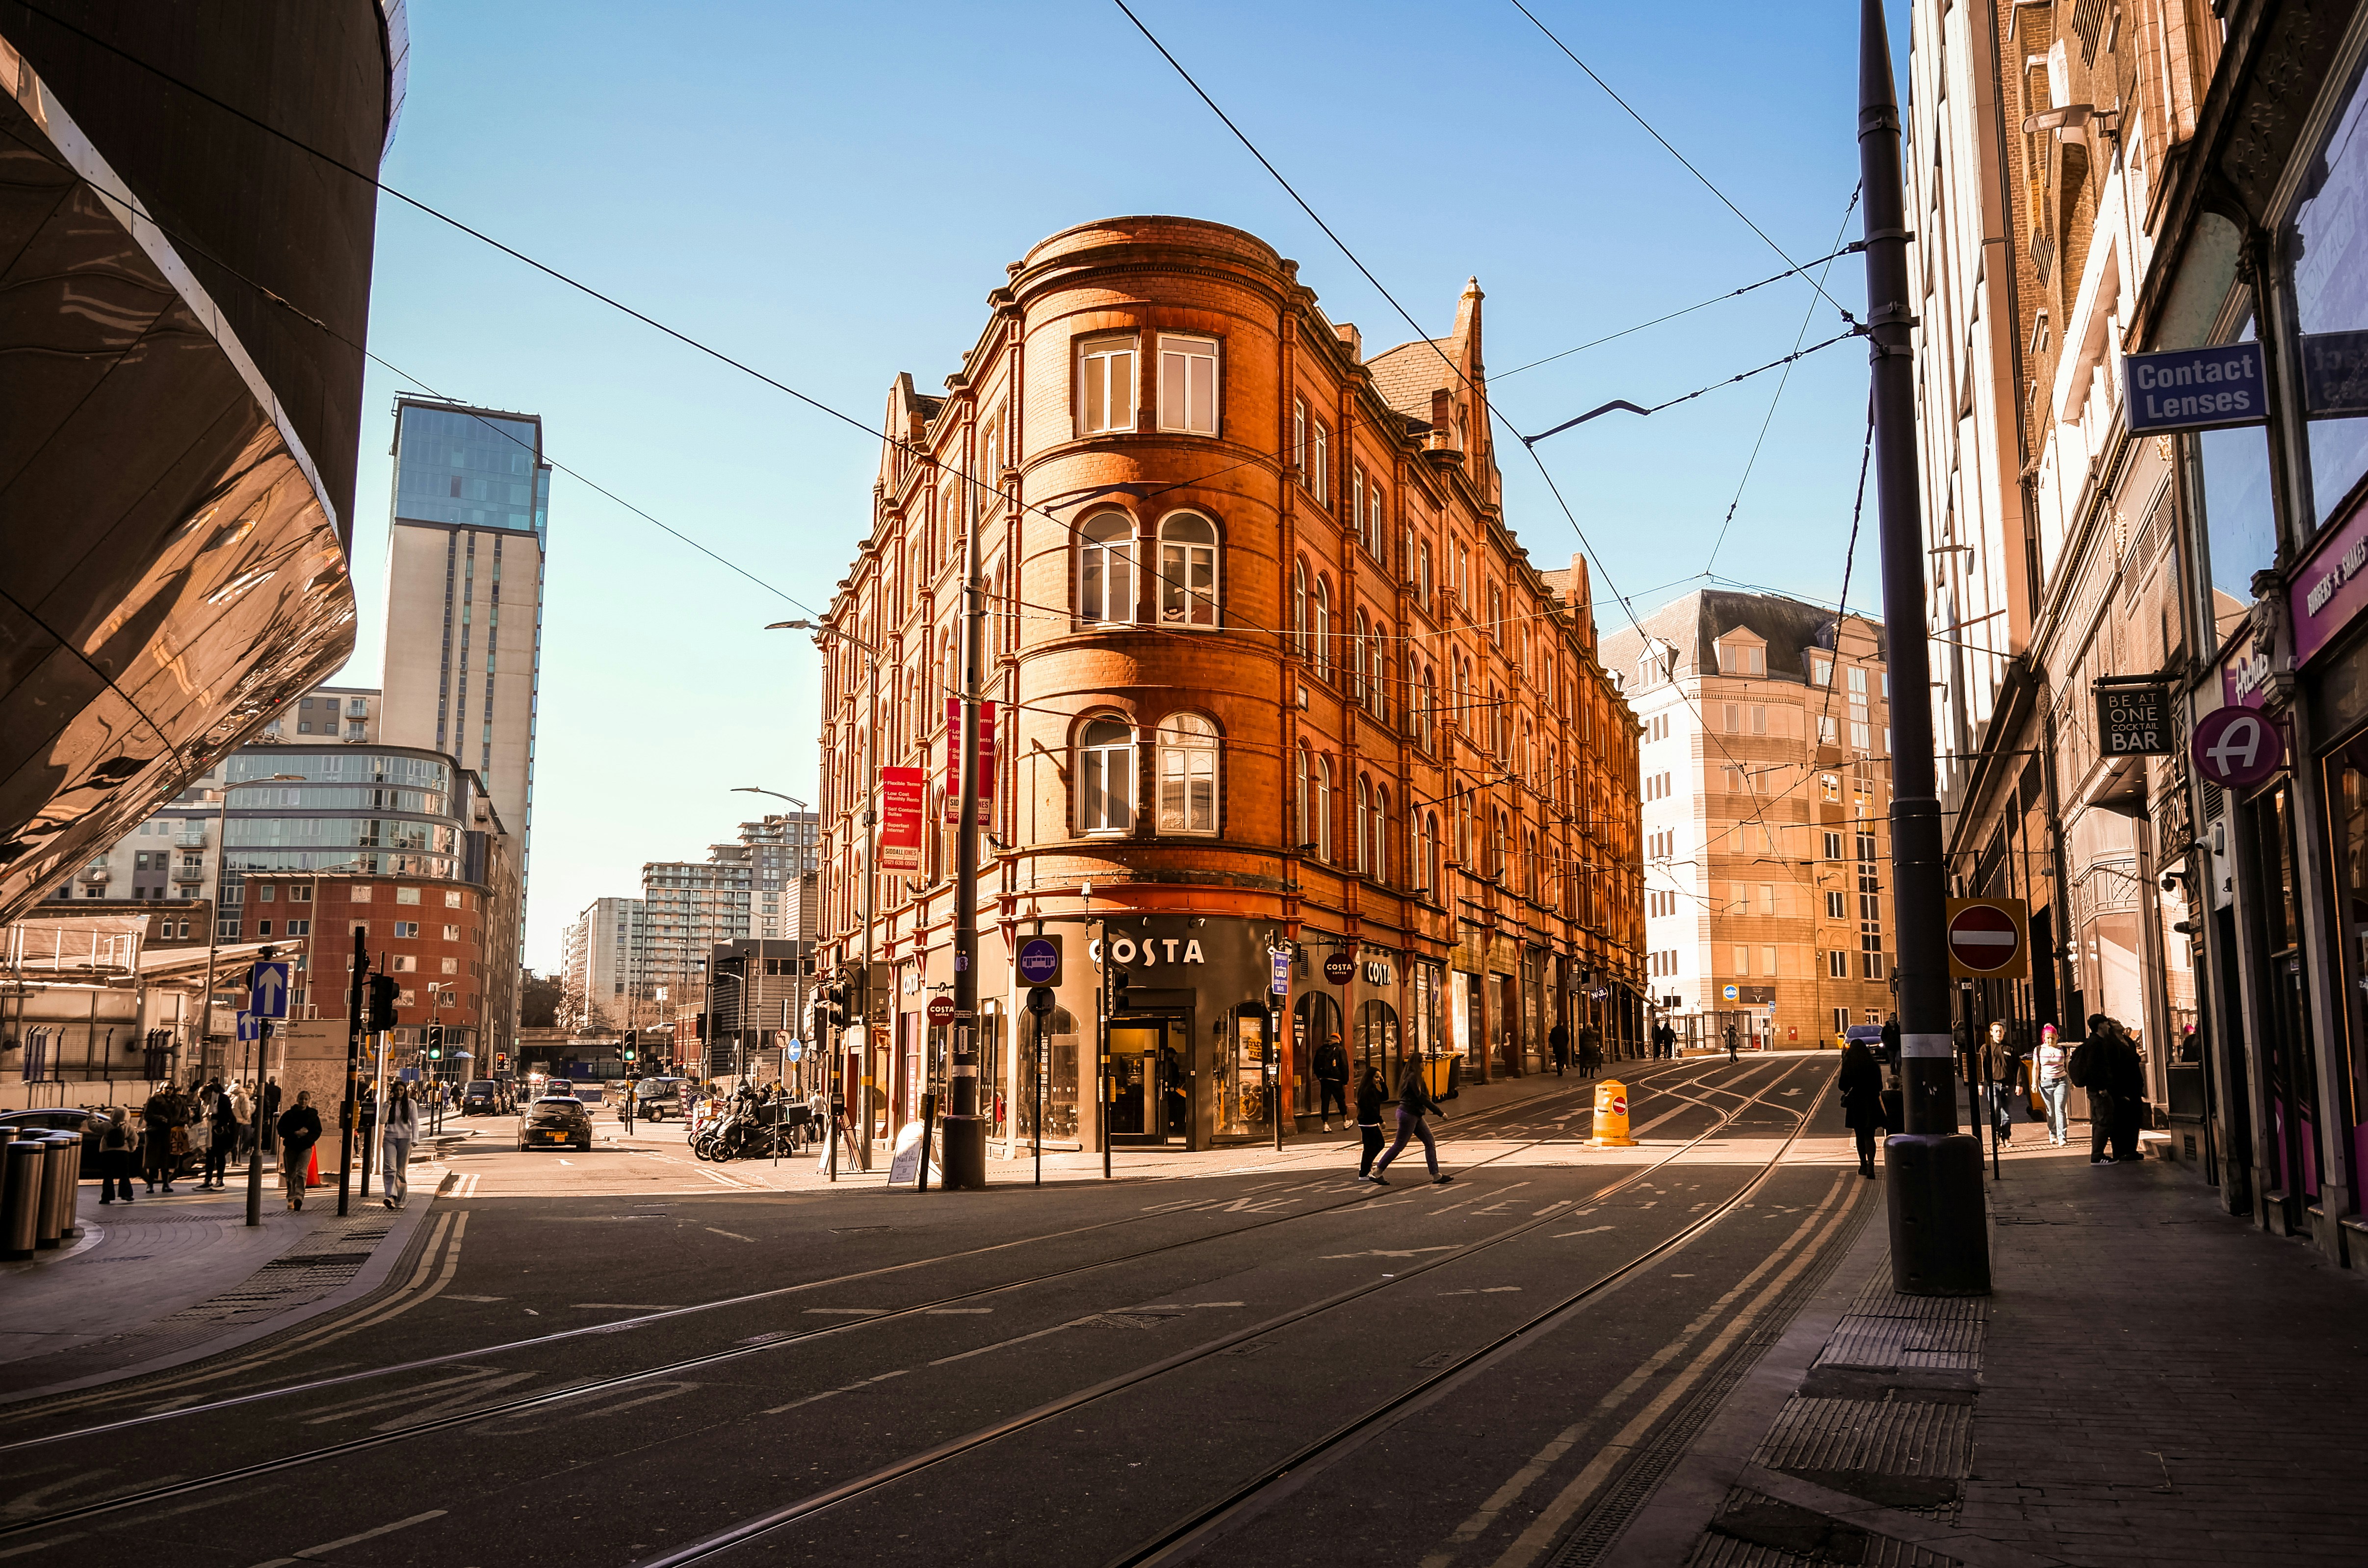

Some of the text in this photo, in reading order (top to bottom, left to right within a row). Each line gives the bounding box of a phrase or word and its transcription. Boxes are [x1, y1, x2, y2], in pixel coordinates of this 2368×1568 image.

[2137, 355, 2254, 389] Contact
[2146, 390, 2250, 418] Lenses
[2307, 536, 2365, 617] BURGERS SHAKES
[2109, 694, 2157, 708] BE AT
[2110, 707, 2158, 723] ONE
[2111, 722, 2159, 732] COCKTAIL
[2111, 732, 2160, 751] BAR
[2206, 717, 2260, 776] A
[903, 849, 916, 859] JONES
[1089, 938, 1205, 967] COSTA
[904, 973, 918, 995] COSTA
[1368, 961, 1391, 986] COSTA
